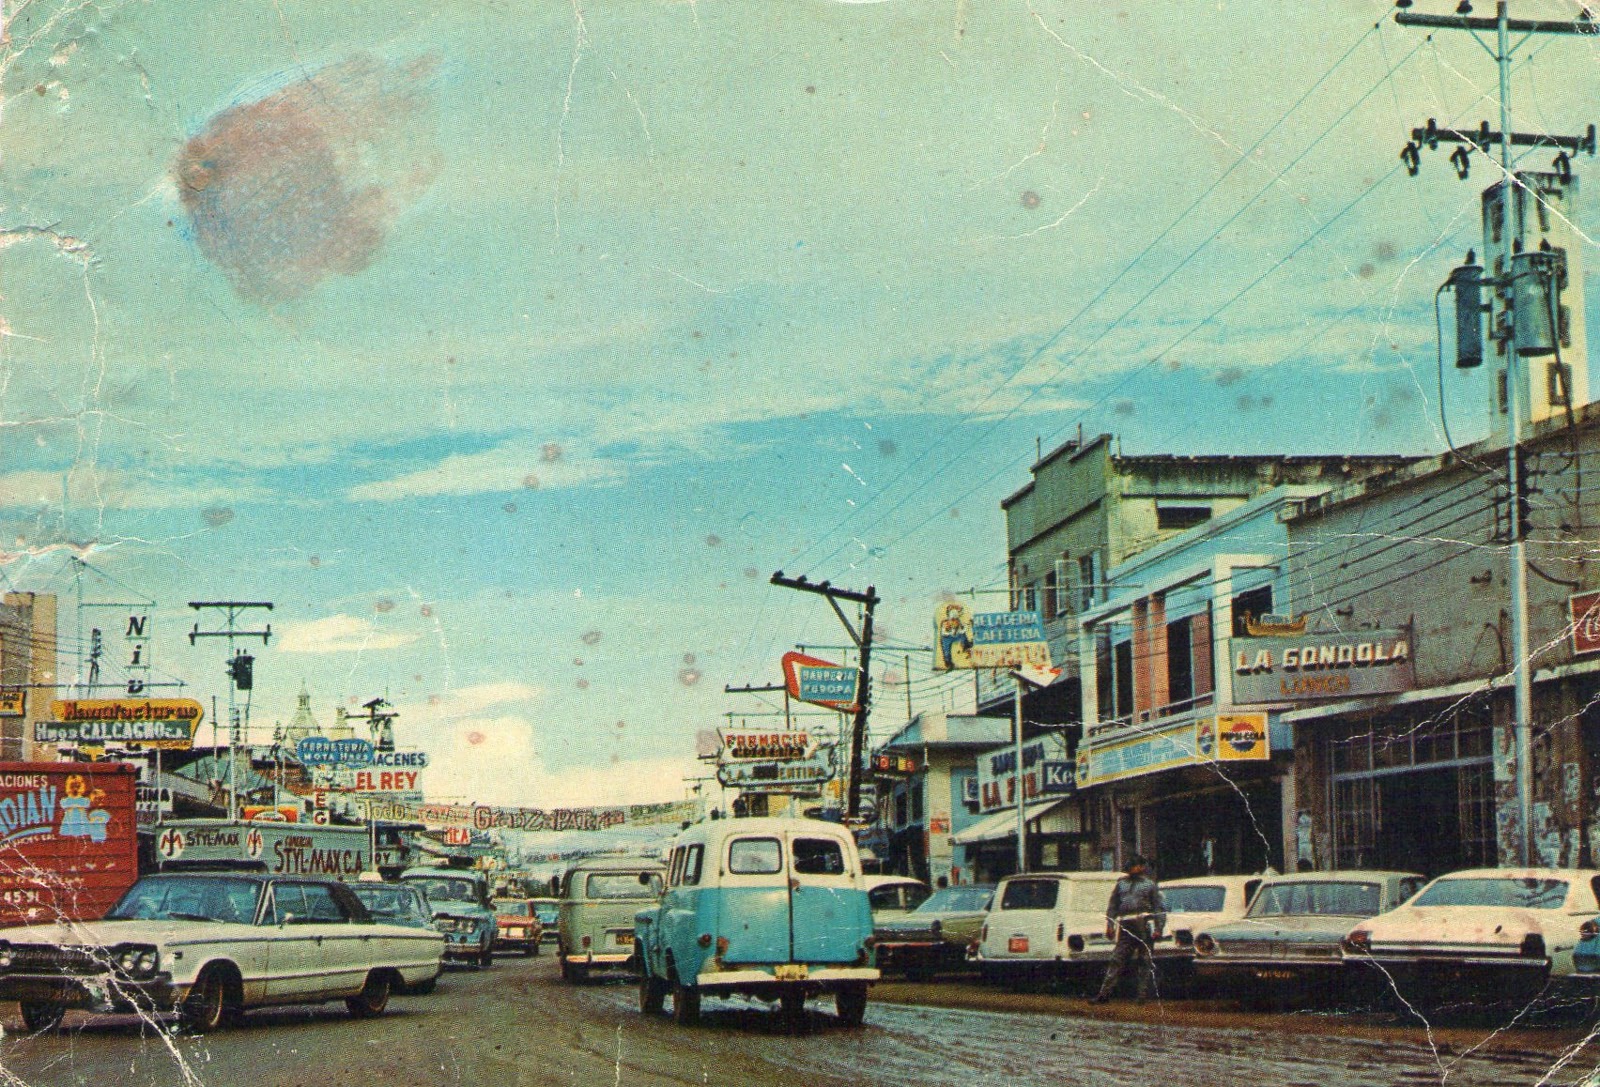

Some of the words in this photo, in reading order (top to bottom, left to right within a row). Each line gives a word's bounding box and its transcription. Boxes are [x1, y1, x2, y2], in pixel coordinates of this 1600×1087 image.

[1237, 649, 1272, 674] LA
[1282, 640, 1409, 671] GONDOLA
[1280, 675, 1351, 695] LUNCH
[726, 733, 808, 749] FARMACIA
[374, 751, 427, 768] ACENES
[356, 771, 377, 791] EL
[380, 771, 418, 790] REY
[1047, 766, 1077, 785] Ke
